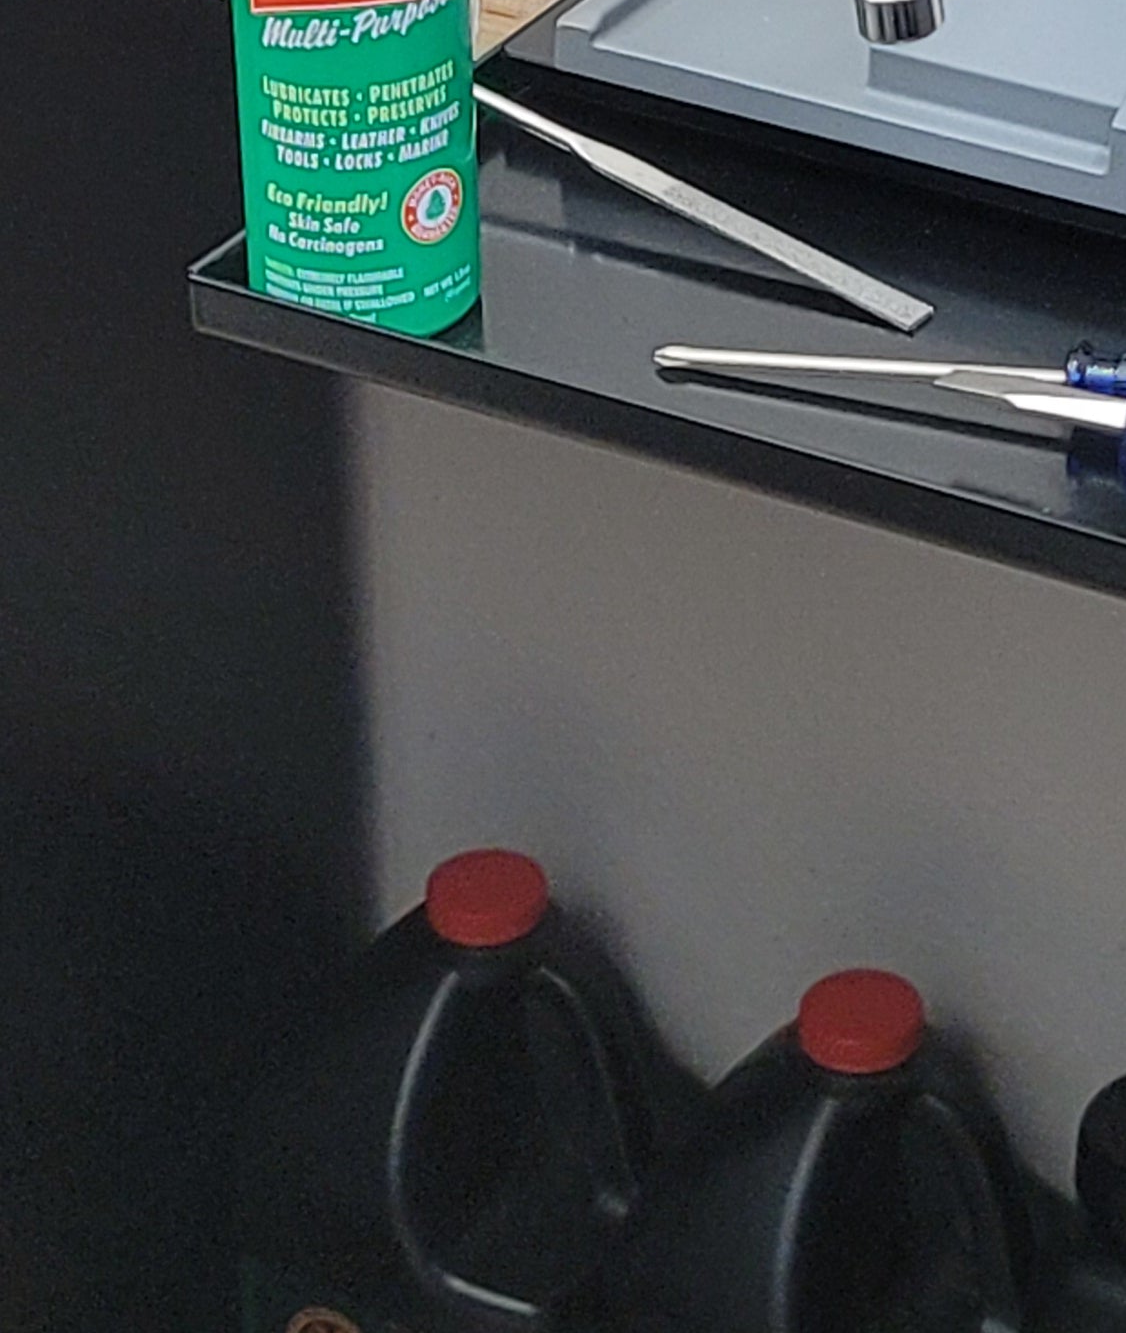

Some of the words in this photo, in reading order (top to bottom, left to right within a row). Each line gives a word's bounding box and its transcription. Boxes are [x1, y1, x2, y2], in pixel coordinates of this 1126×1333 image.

[262, 75, 351, 107] LUBRICATES
[369, 59, 455, 104] PENETRATES
[261, 119, 326, 150] FIREARMS
[341, 126, 406, 151] LEATHER
[419, 101, 461, 136] KNIVES
[272, 102, 348, 127] PROTECTS
[367, 84, 448, 126] PRESERVES
[276, 144, 319, 170] TOOLS
[335, 150, 383, 171] LOCKS
[398, 128, 450, 164] MARINE
[266, 182, 293, 208] Eco
[296, 190, 389, 218] Friendly!
[268, 224, 287, 247] No
[288, 233, 385, 258] Carcinogens
[288, 212, 320, 232] Skin
[324, 214, 361, 235] Safe
